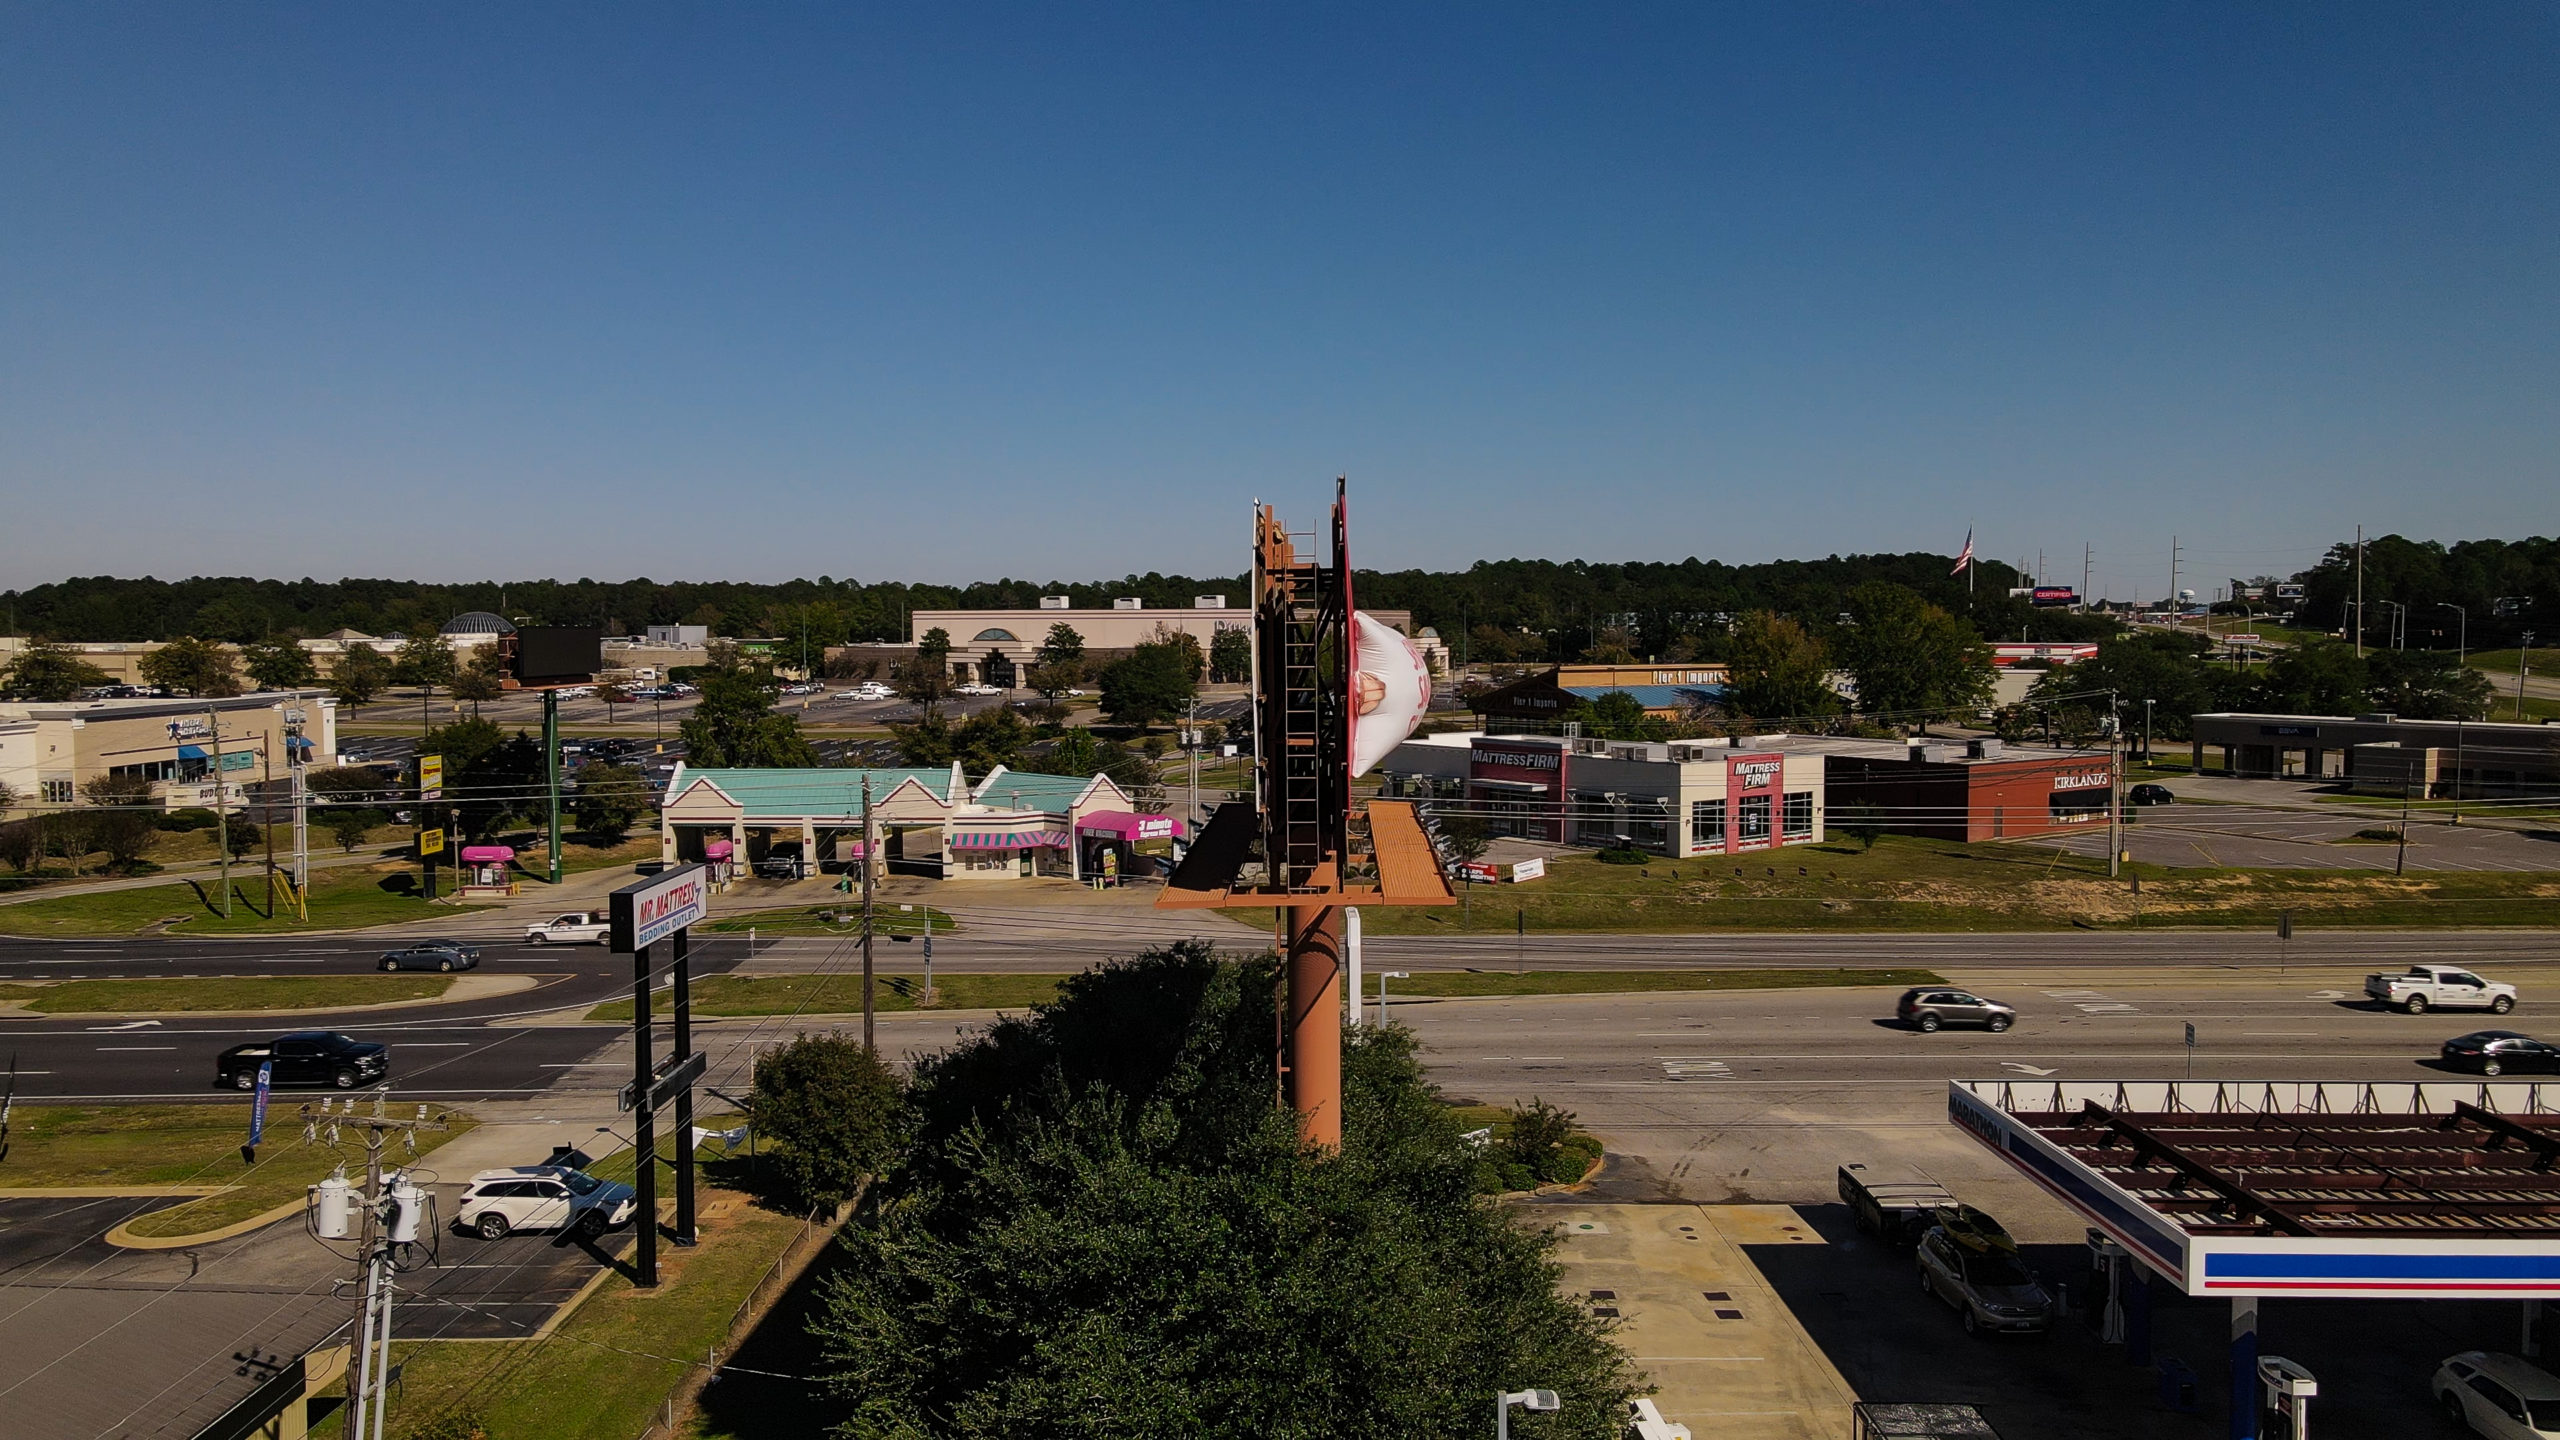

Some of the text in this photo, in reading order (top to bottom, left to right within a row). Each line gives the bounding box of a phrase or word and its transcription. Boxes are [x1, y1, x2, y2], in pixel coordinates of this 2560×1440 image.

[1652, 668, 1724, 684] Pier 1 Imports
[1735, 762, 1780, 775] MATTRESS
[1745, 773, 1771, 786] FIRM
[1138, 818, 1173, 831] 3 minute
[639, 881, 696, 926] MR. MATTRESS
[639, 909, 696, 944] BEDDING OUTLET
[1949, 1093, 2002, 1147] MARATHON
